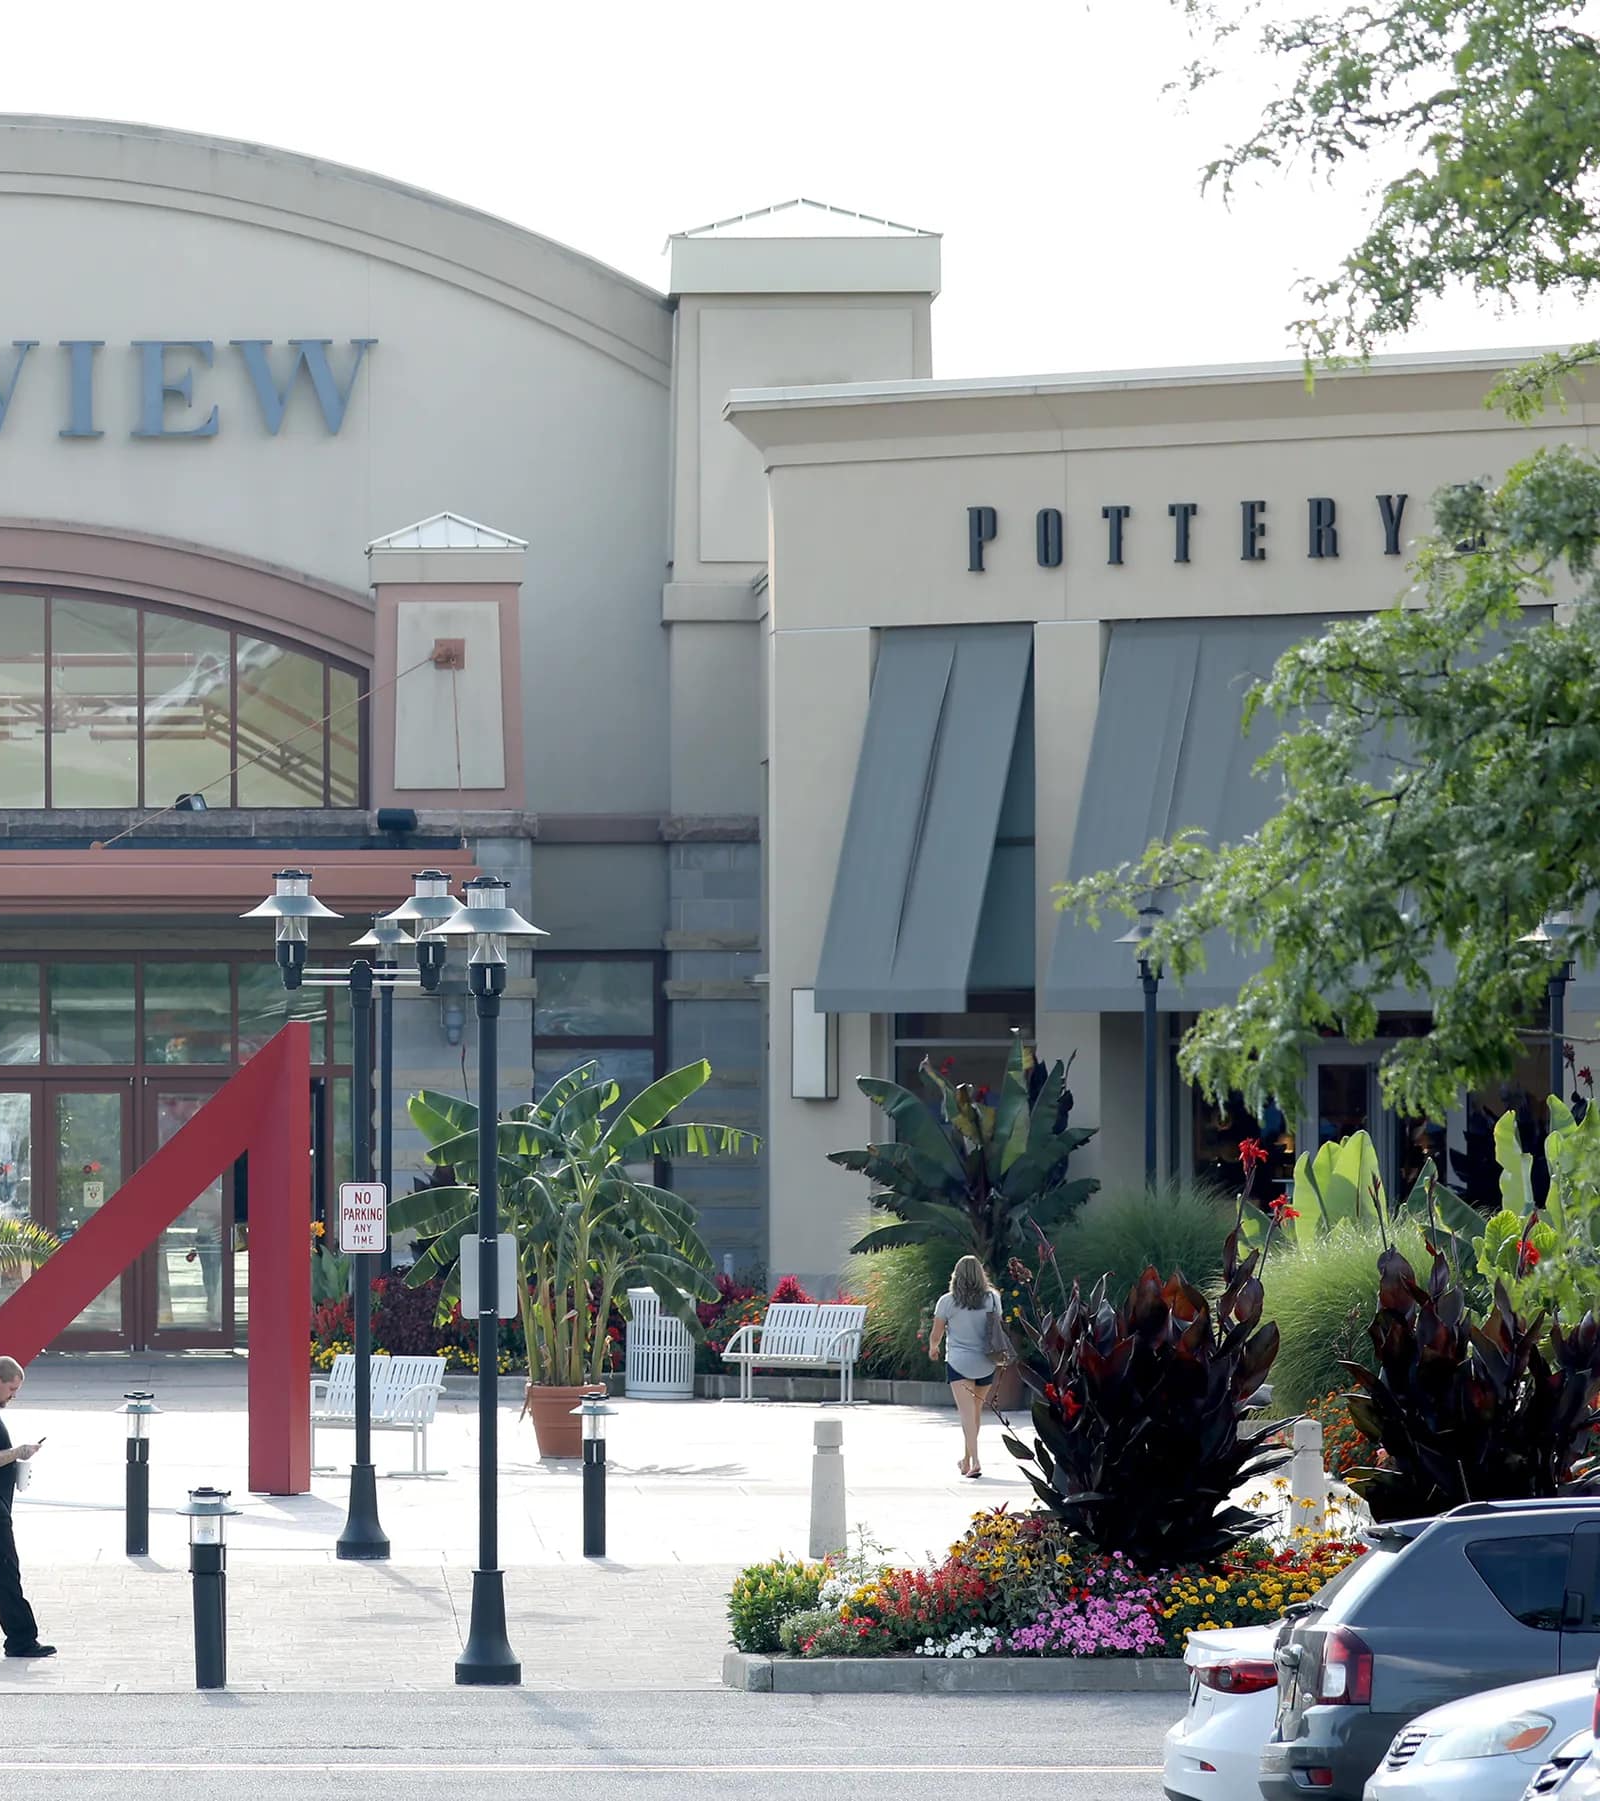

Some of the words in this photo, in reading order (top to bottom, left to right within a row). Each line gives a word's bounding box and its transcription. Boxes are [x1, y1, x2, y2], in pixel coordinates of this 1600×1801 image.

[966, 493, 1409, 573] POTTERY
[354, 1191, 372, 1205] NO
[343, 1207, 383, 1221] PARKING
[354, 1223, 373, 1233] ANY
[352, 1235, 374, 1245] TIME
